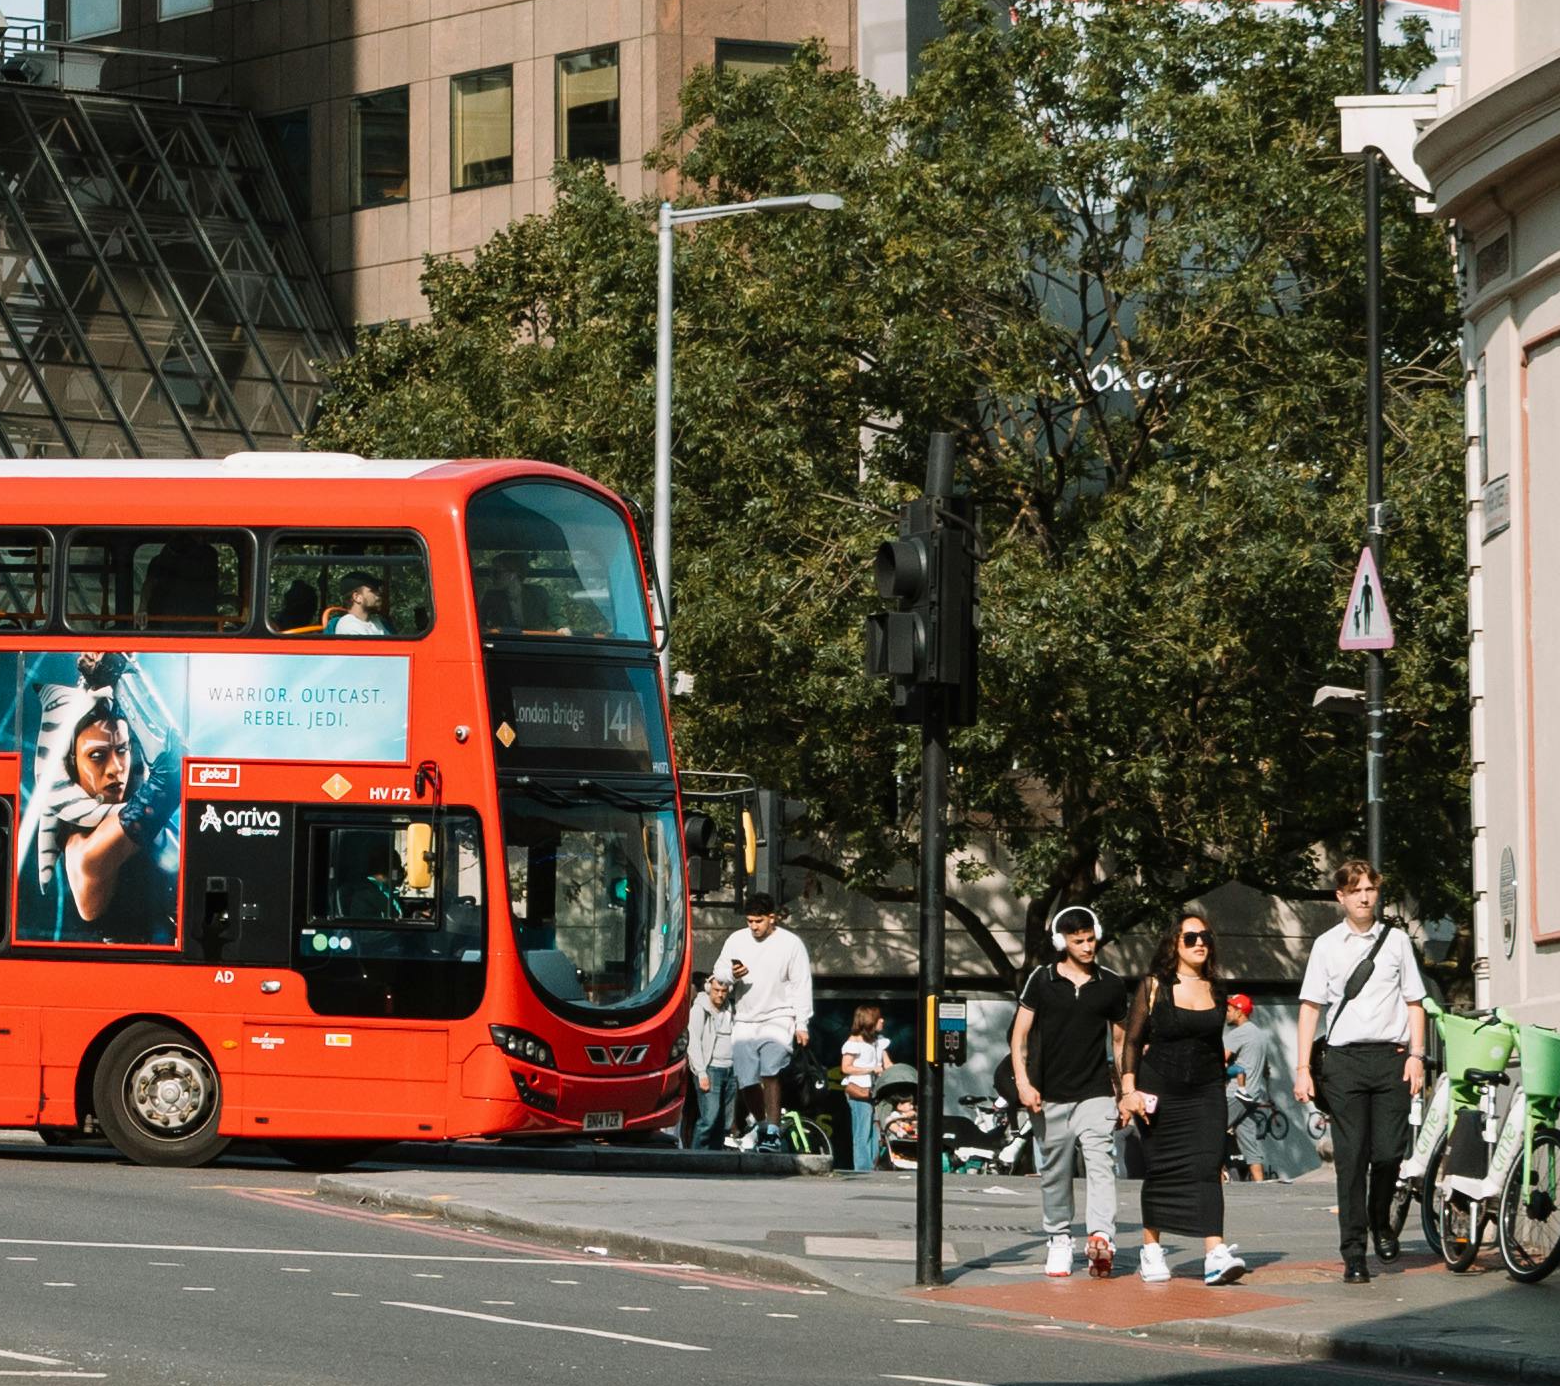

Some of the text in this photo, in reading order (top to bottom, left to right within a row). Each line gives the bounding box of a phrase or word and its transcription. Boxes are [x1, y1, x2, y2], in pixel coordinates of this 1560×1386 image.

[208, 686, 387, 705] WARRIOR. OUTCAST.
[243, 710, 349, 730] REBEL. JEDI.
[513, 699, 585, 732] London Bridge
[603, 699, 633, 742] 141
[199, 767, 230, 783] global
[369, 788, 411, 801] HV 172
[224, 807, 280, 827] arriva
[214, 970, 235, 984] AD
